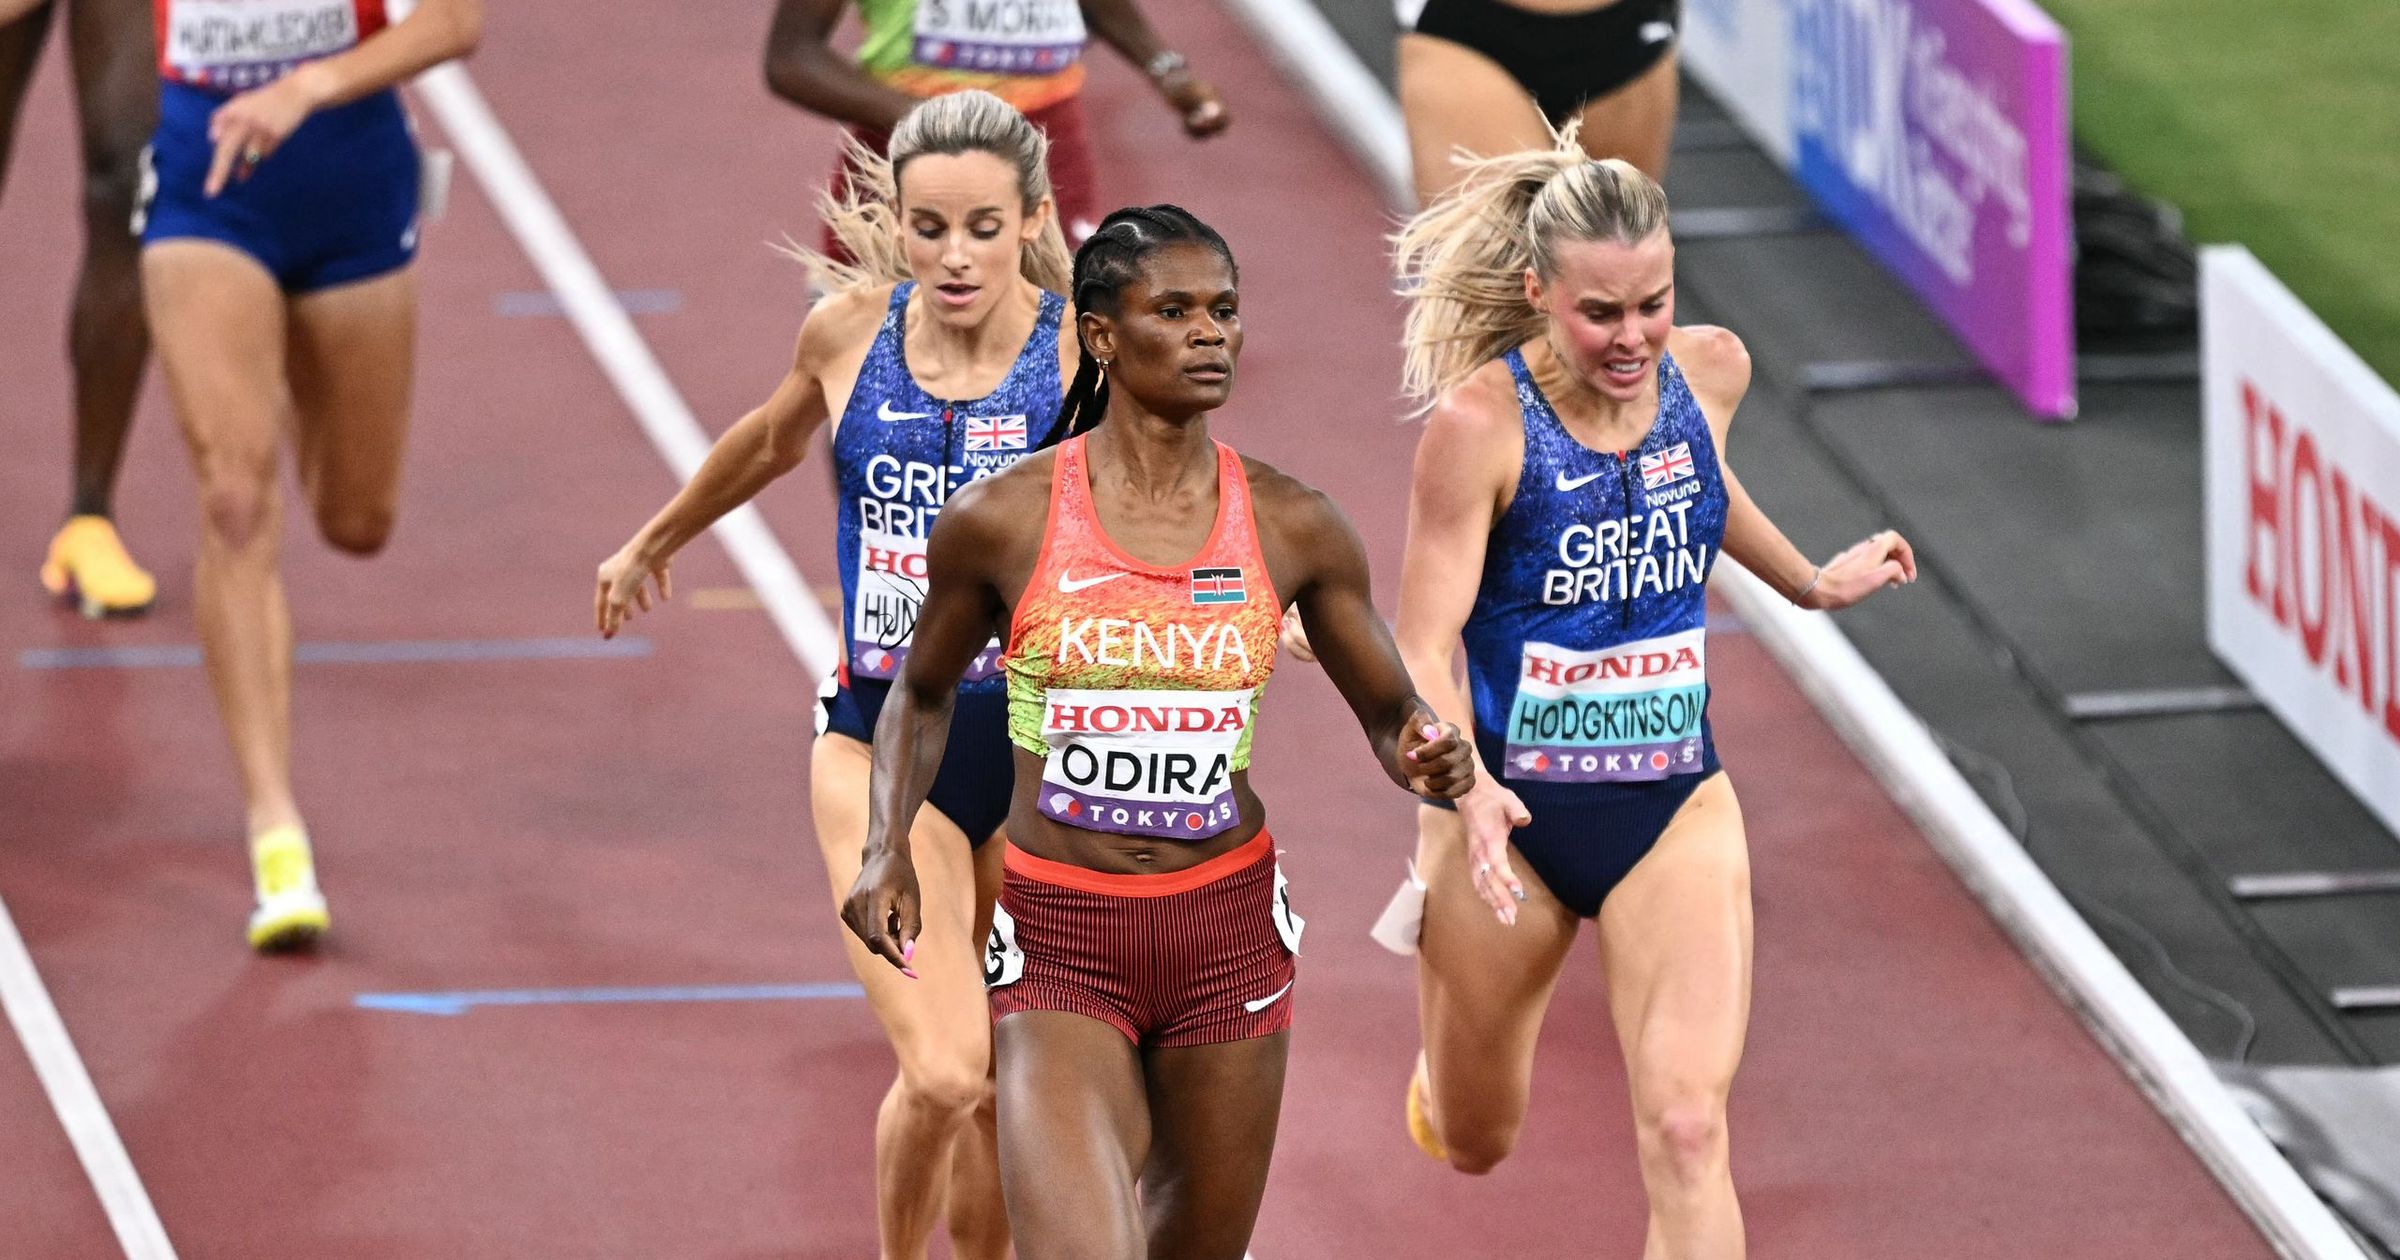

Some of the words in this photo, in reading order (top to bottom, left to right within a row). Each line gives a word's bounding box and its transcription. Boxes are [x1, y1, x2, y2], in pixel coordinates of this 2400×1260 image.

[1645, 480, 1701, 509] Novuna
[1559, 500, 1693, 568] GREAT
[1543, 543, 1706, 605] BRITAIN
[1058, 616, 1251, 673] KENYA
[1525, 647, 1701, 687] HONDA
[1048, 704, 1245, 733] HONDA
[1518, 691, 1699, 741] HODGKINSON
[1061, 743, 1227, 796] ODIRA
